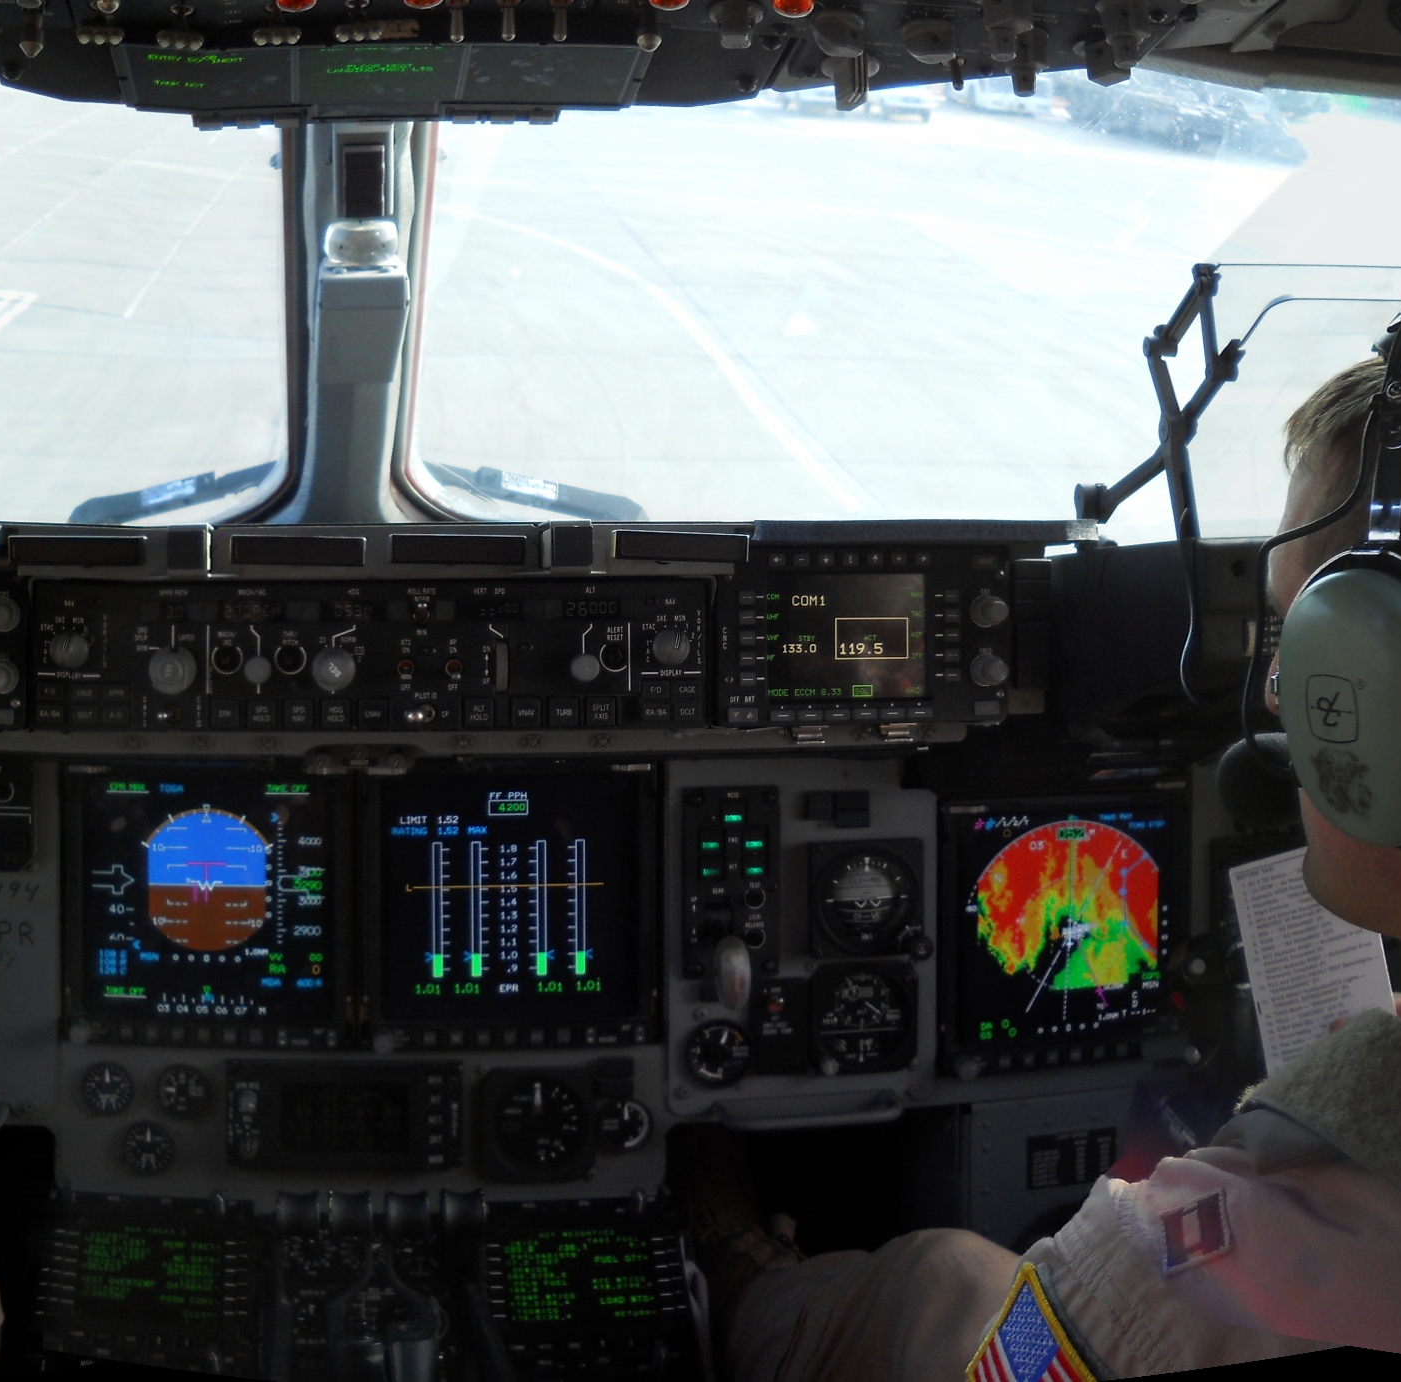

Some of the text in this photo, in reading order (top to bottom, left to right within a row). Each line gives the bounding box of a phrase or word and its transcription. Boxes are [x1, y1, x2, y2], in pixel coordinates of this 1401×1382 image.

[791, 595, 826, 607] COM1
[566, 602, 617, 617] 26000
[642, 623, 656, 631] ETAC
[782, 643, 817, 654] 133.0
[839, 643, 883, 655] 119.5
[768, 688, 842, 697] MODE ECCM 8.33
[473, 705, 485, 713] ALT
[556, 708, 572, 716] TURB
[592, 704, 609, 712] SPLIT
[645, 708, 695, 716] RA/BA DCLT
[39, 710, 60, 719] RA/BA
[470, 713, 488, 721] HOLD
[518, 709, 535, 717] VNAV
[594, 712, 609, 720] AXIS
[327, 714, 345, 722] HOLD
[290, 784, 309, 792] OFF
[489, 791, 528, 799] FF PPH
[498, 803, 525, 812] 4200
[400, 815, 460, 824] LIMIT 1.52
[724, 814, 742, 822] DOWN
[391, 825, 488, 836] RATING 1.52 MAX
[298, 836, 322, 846] 4000
[745, 840, 764, 848] DOWN
[1029, 841, 1045, 850] 03
[500, 844, 518, 853] 1.8
[500, 857, 518, 866] 1.7
[500, 871, 518, 880] 1.6
[500, 898, 518, 906] 1.4
[109, 905, 124, 913] 40
[500, 911, 518, 919] 1.3
[251, 919, 263, 927] 10
[293, 926, 322, 936] 2900
[500, 924, 518, 933] 1.2
[500, 937, 518, 946] 1.1
[140, 952, 160, 962] MSN
[500, 951, 518, 959] 1.0
[269, 964, 321, 974] RA 0
[129, 986, 146, 995] OFF
[414, 979, 602, 994] 1.01 1.01 EPR 1.01 1.01
[1131, 991, 1138, 999] C
[157, 1004, 248, 1015] 03 04 05 06 07
[1001, 1018, 1010, 1029] 0
[1008, 1026, 1017, 1038] 0
